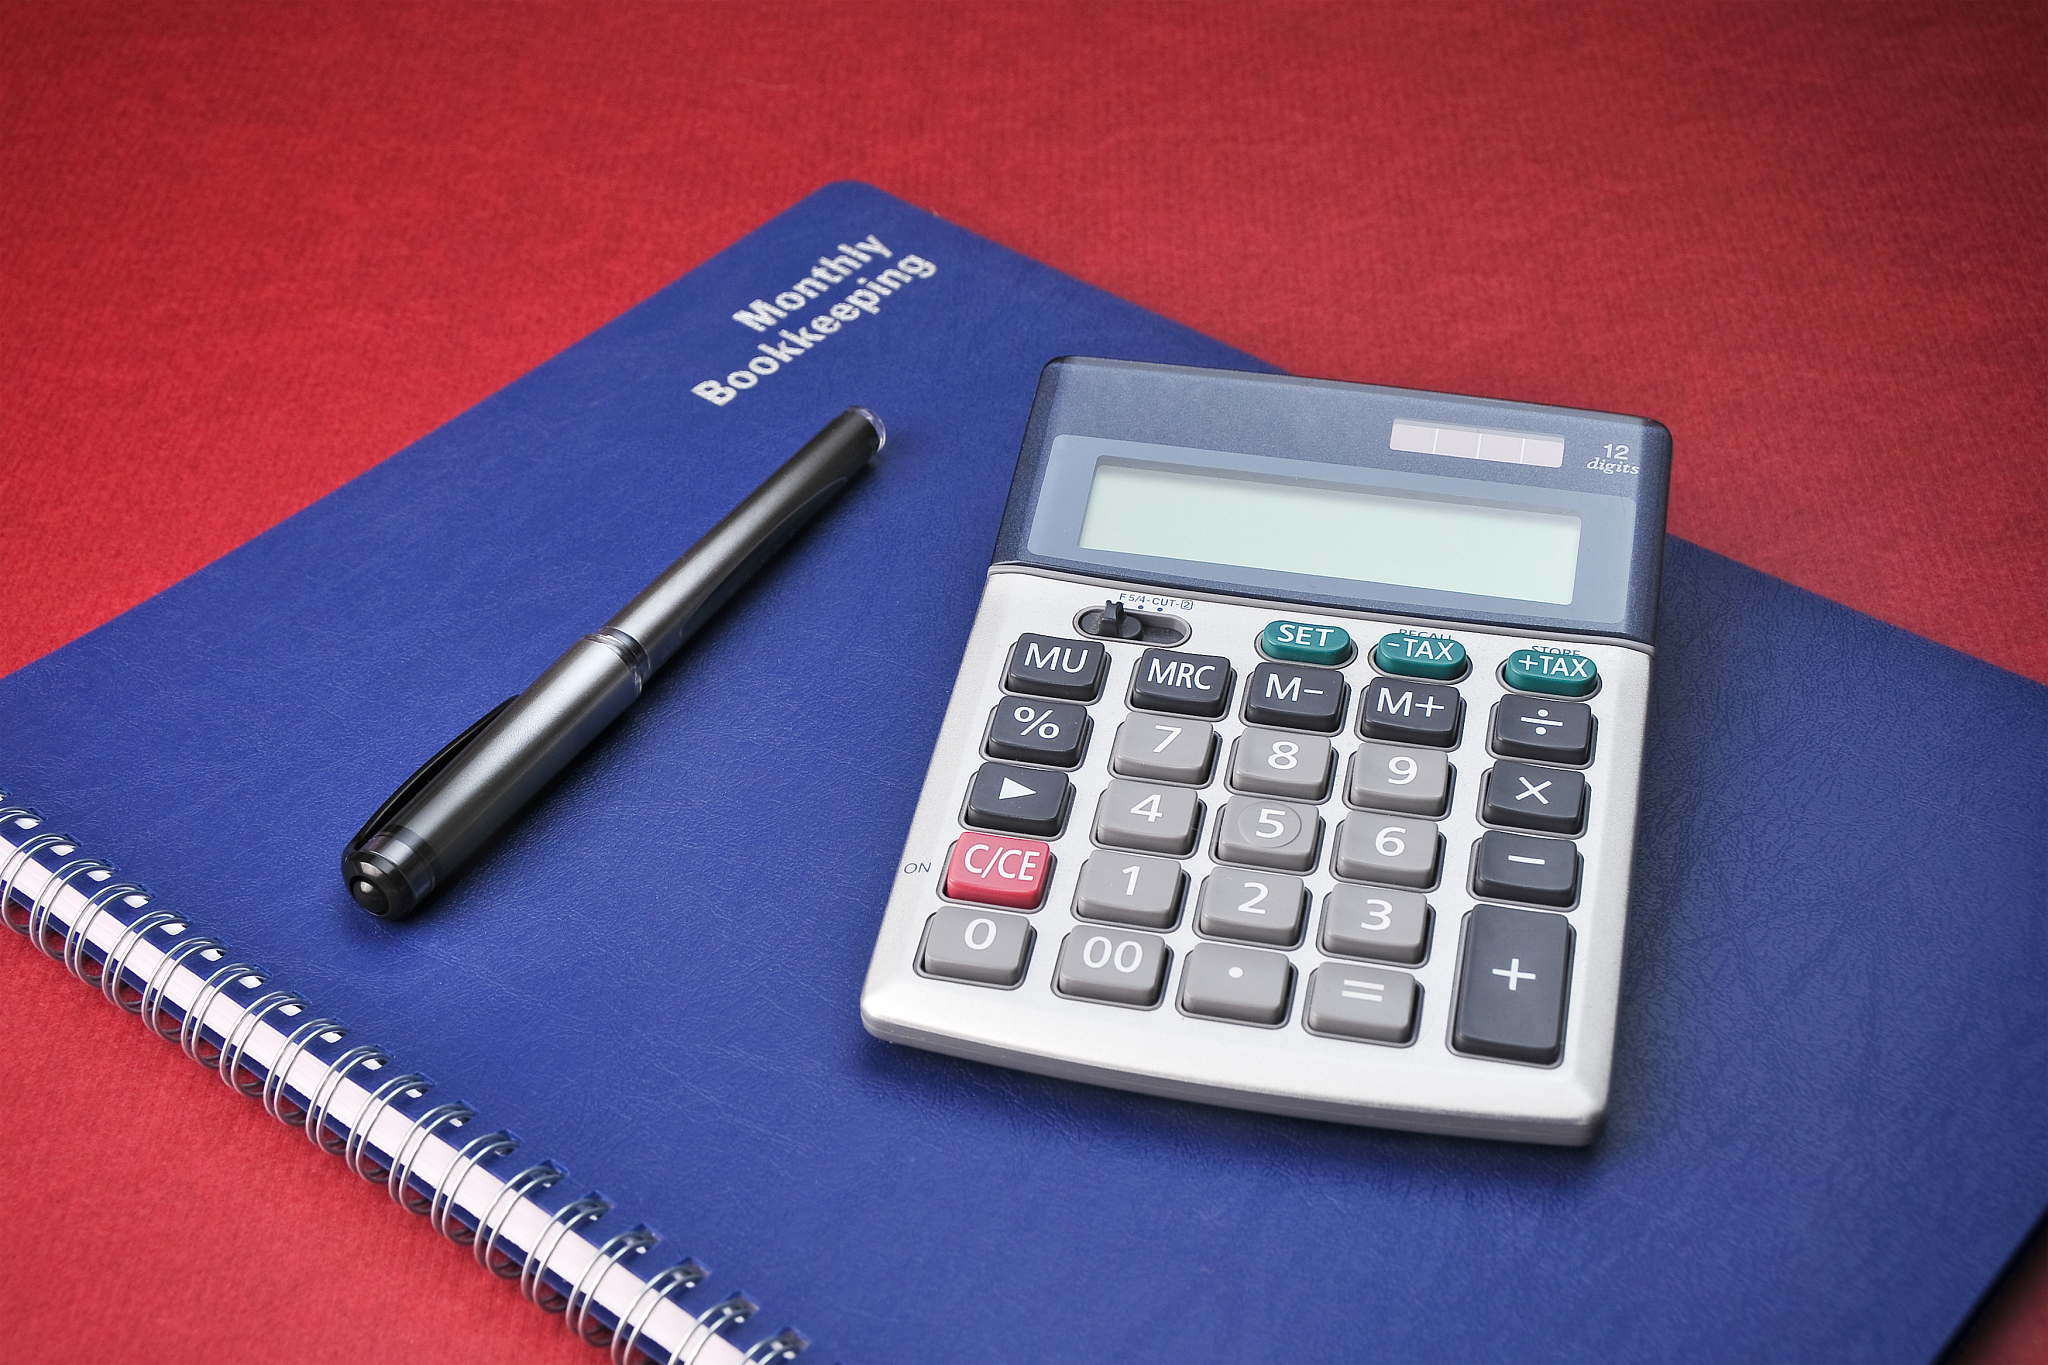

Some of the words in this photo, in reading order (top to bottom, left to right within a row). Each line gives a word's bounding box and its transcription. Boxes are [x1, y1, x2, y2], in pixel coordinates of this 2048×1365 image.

[732, 234, 893, 332] Monthly
[690, 254, 937, 406] Bookkeeping
[1586, 457, 1640, 475] digits
[1603, 443, 1630, 460] 12
[1277, 624, 1334, 648] SET
[1023, 642, 1089, 673] MU
[1518, 655, 1588, 678] +TAX
[1147, 657, 1216, 690] MRC
[1376, 686, 1445, 718] M+
[1013, 706, 1060, 739] %
[1152, 724, 1183, 753] 7
[1266, 740, 1300, 771] 8
[1387, 755, 1418, 785] 9
[1130, 793, 1163, 823] 4
[1255, 808, 1287, 839] 5
[1374, 826, 1407, 857] 6
[903, 862, 931, 875] ON
[963, 843, 1041, 882] C/CE
[1121, 865, 1141, 896] 1
[1237, 881, 1270, 915] 2
[1360, 898, 1393, 931] 3
[963, 917, 997, 951] 0
[1082, 935, 1143, 974] 00
